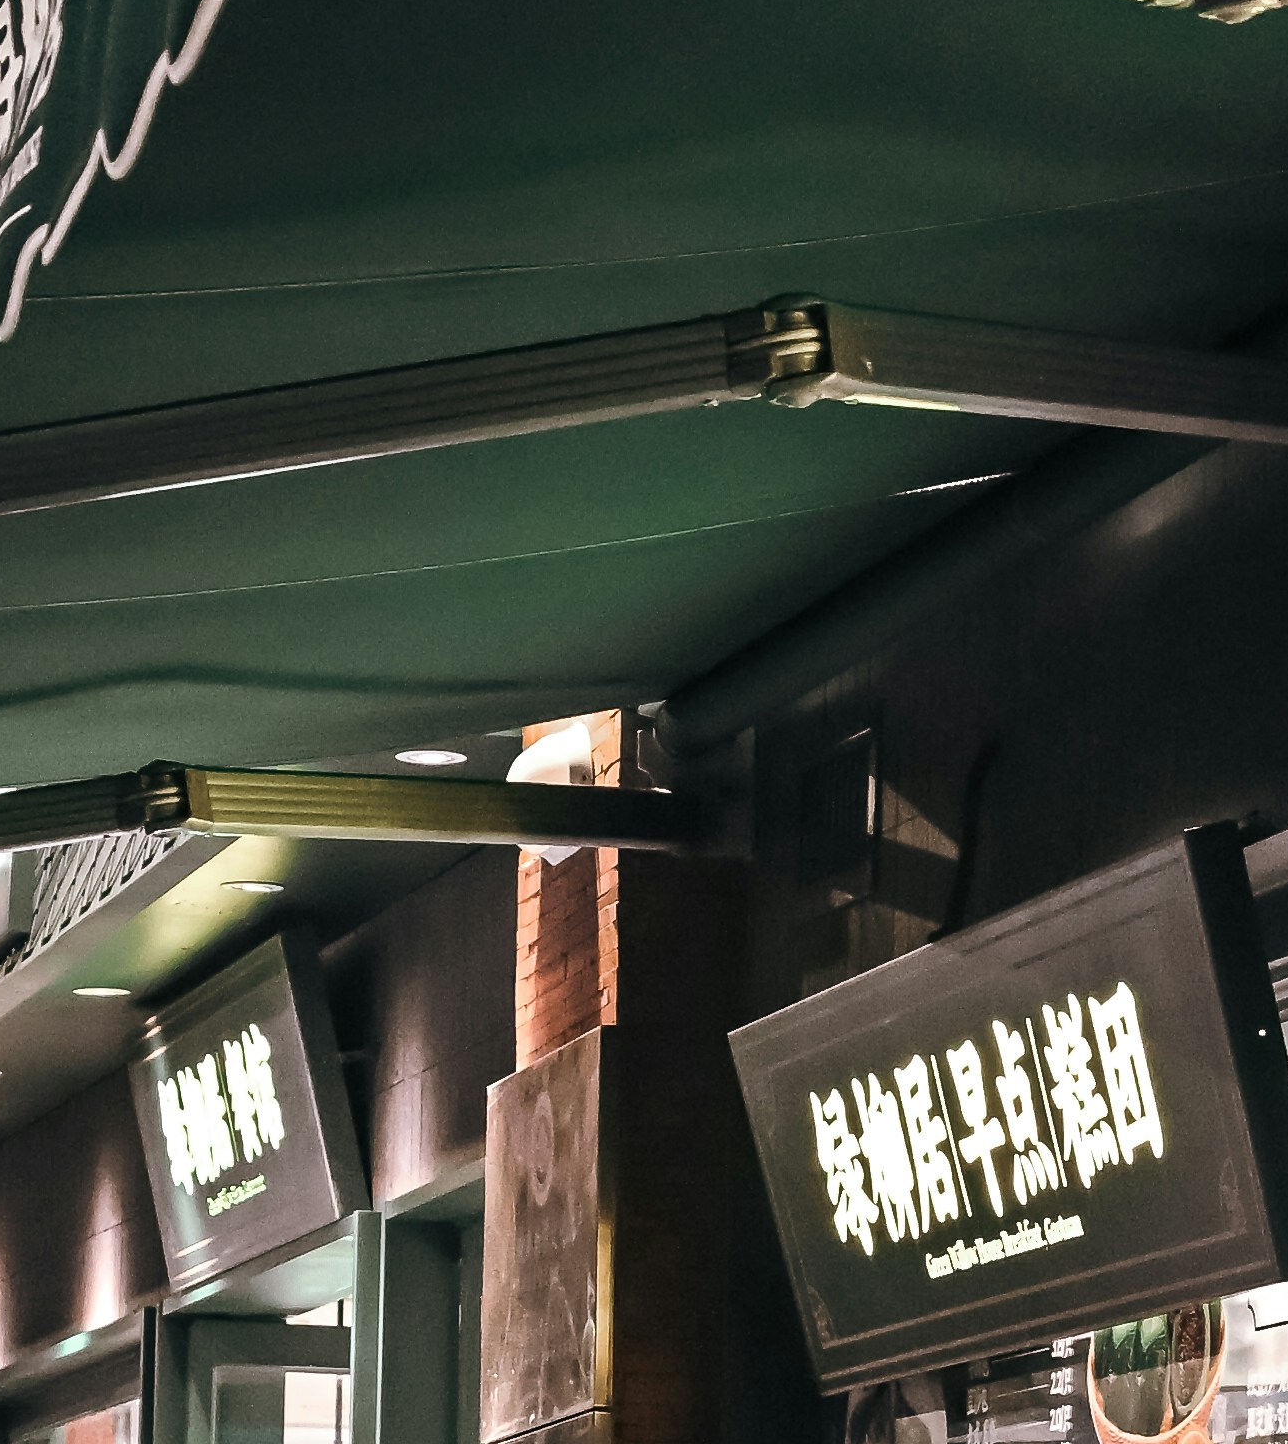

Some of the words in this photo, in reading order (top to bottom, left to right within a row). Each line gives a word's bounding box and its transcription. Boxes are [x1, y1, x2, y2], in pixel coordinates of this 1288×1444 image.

[809, 1053, 959, 1256] 绿柳居
[946, 1019, 1058, 1218] 早点
